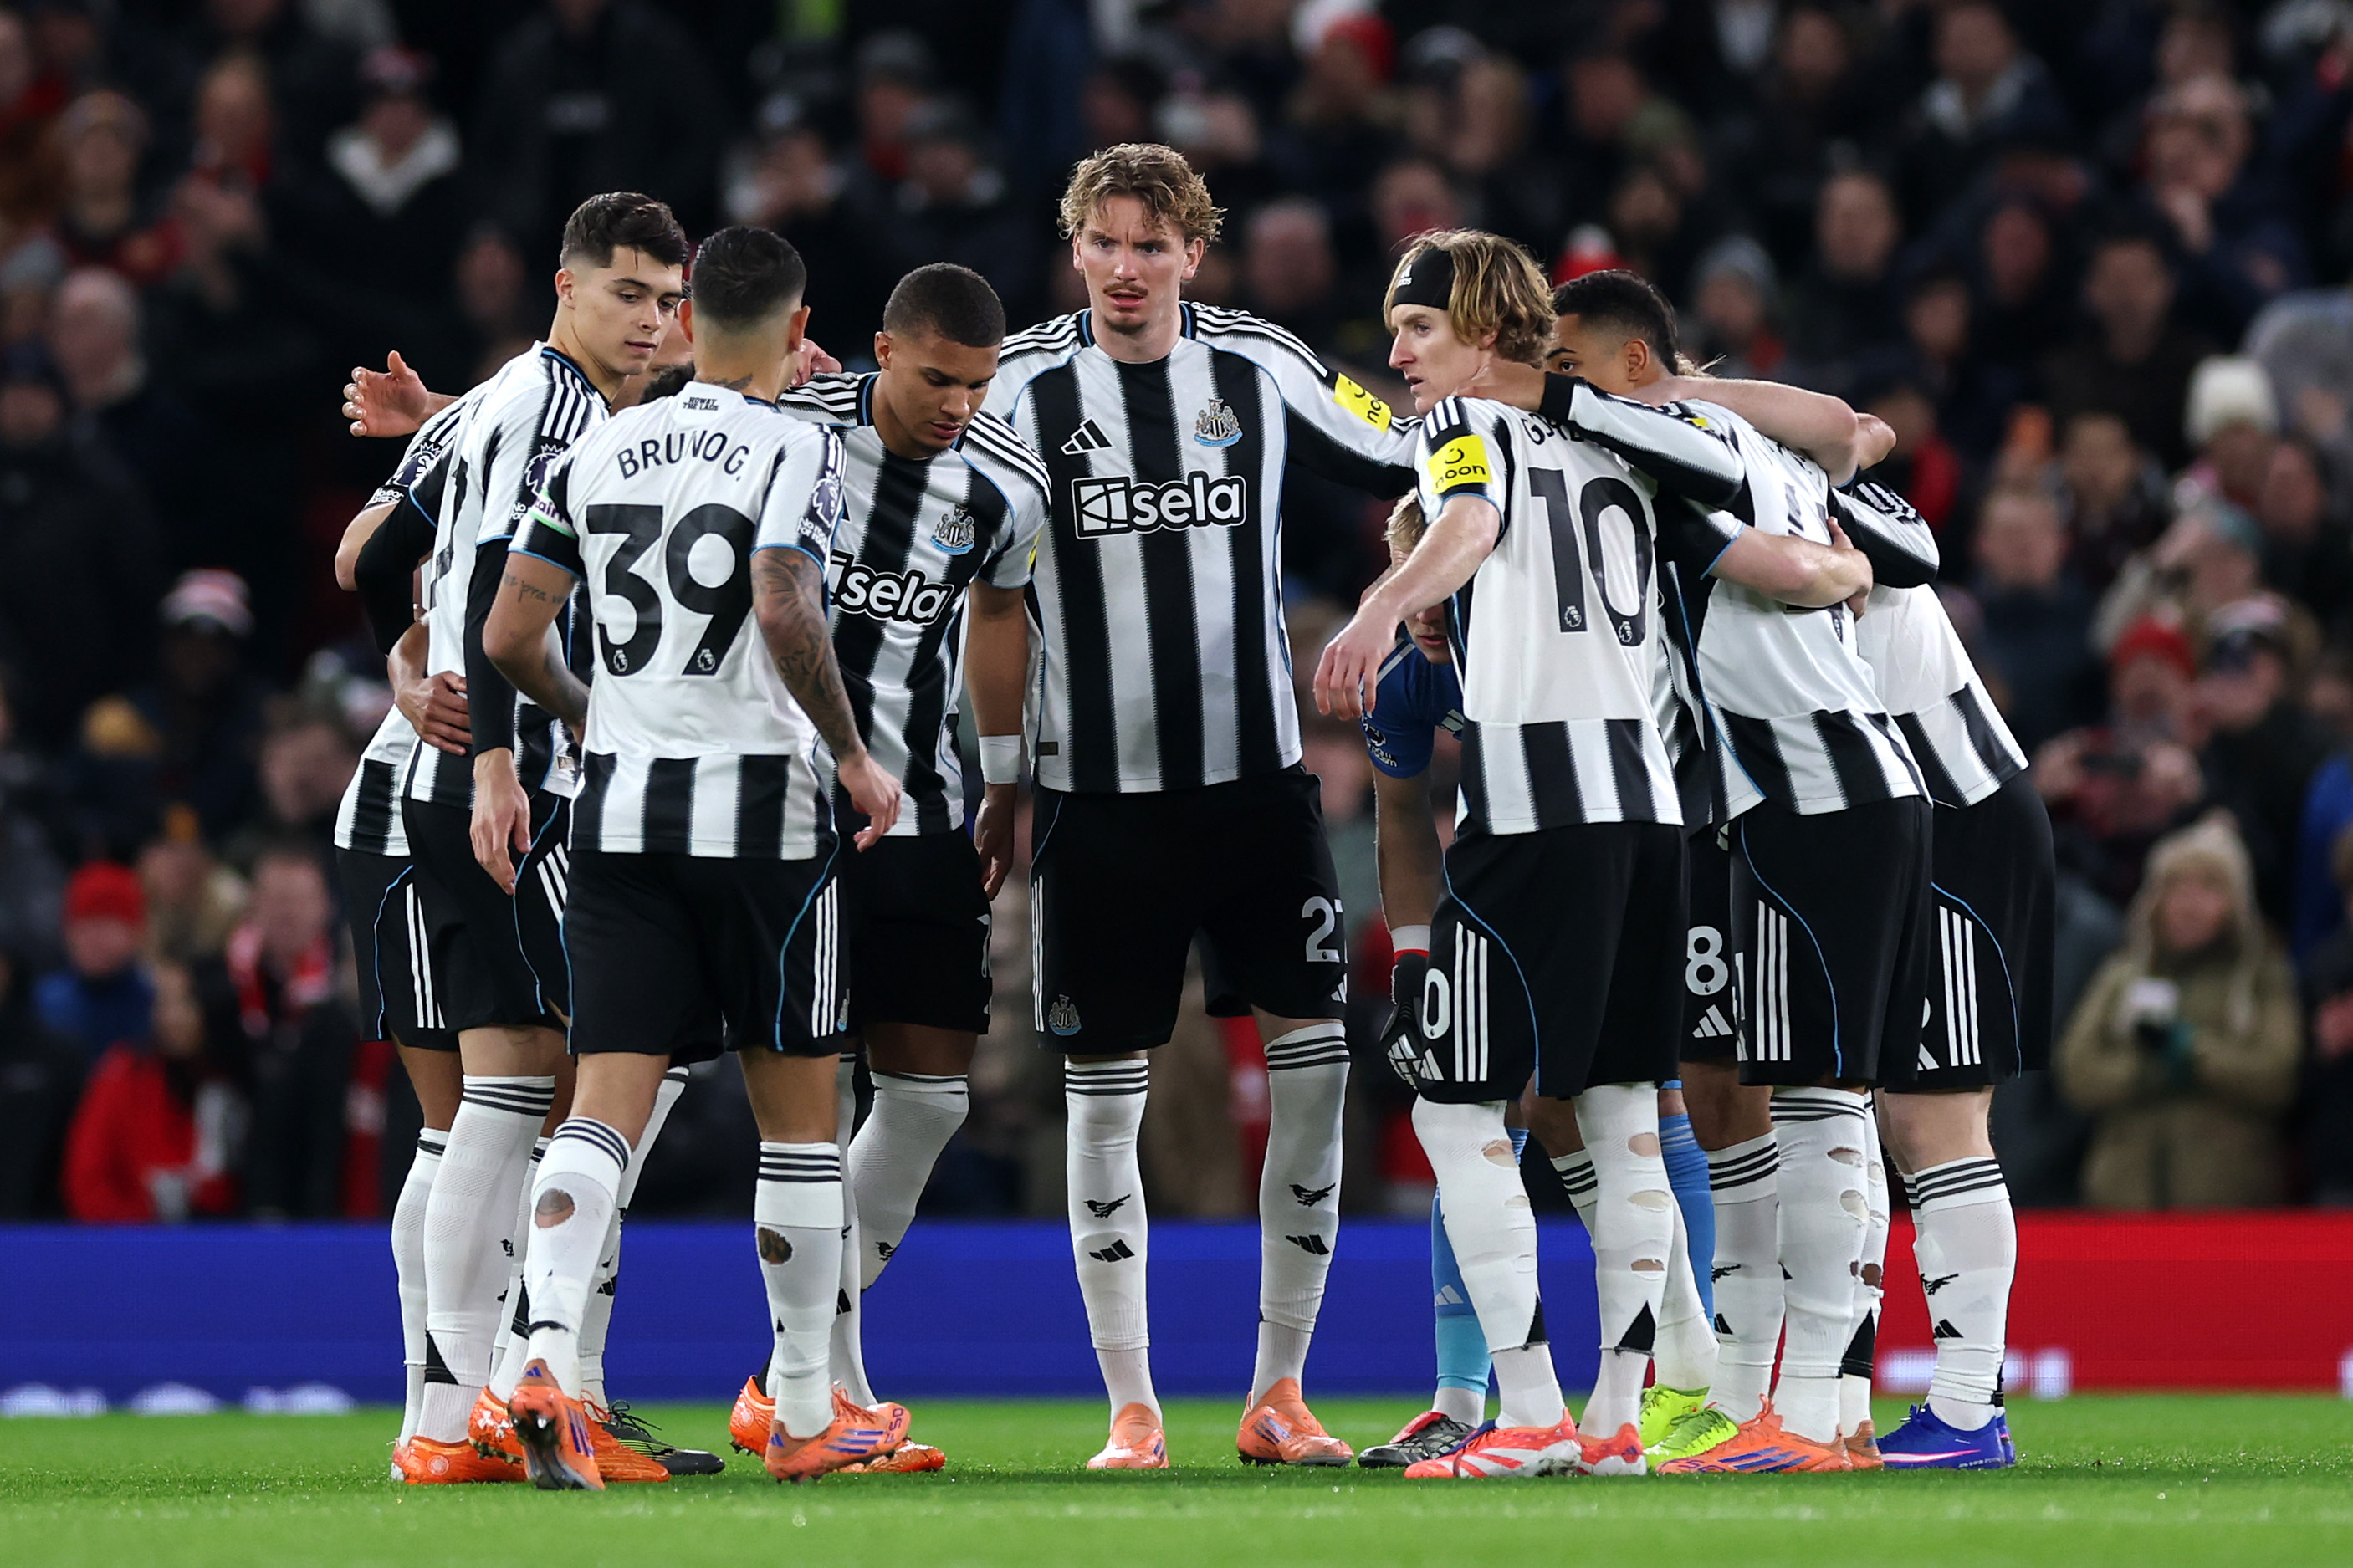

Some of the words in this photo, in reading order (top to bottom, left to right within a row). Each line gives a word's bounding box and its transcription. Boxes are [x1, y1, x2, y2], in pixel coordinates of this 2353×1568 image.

[617, 430, 729, 481] BRUNO
[724, 445, 750, 483] G.
[1435, 464, 1486, 489] noon
[1132, 476, 1240, 526] sela
[1527, 467, 1653, 647] 10
[586, 503, 757, 677] 39
[839, 570, 949, 620] sela
